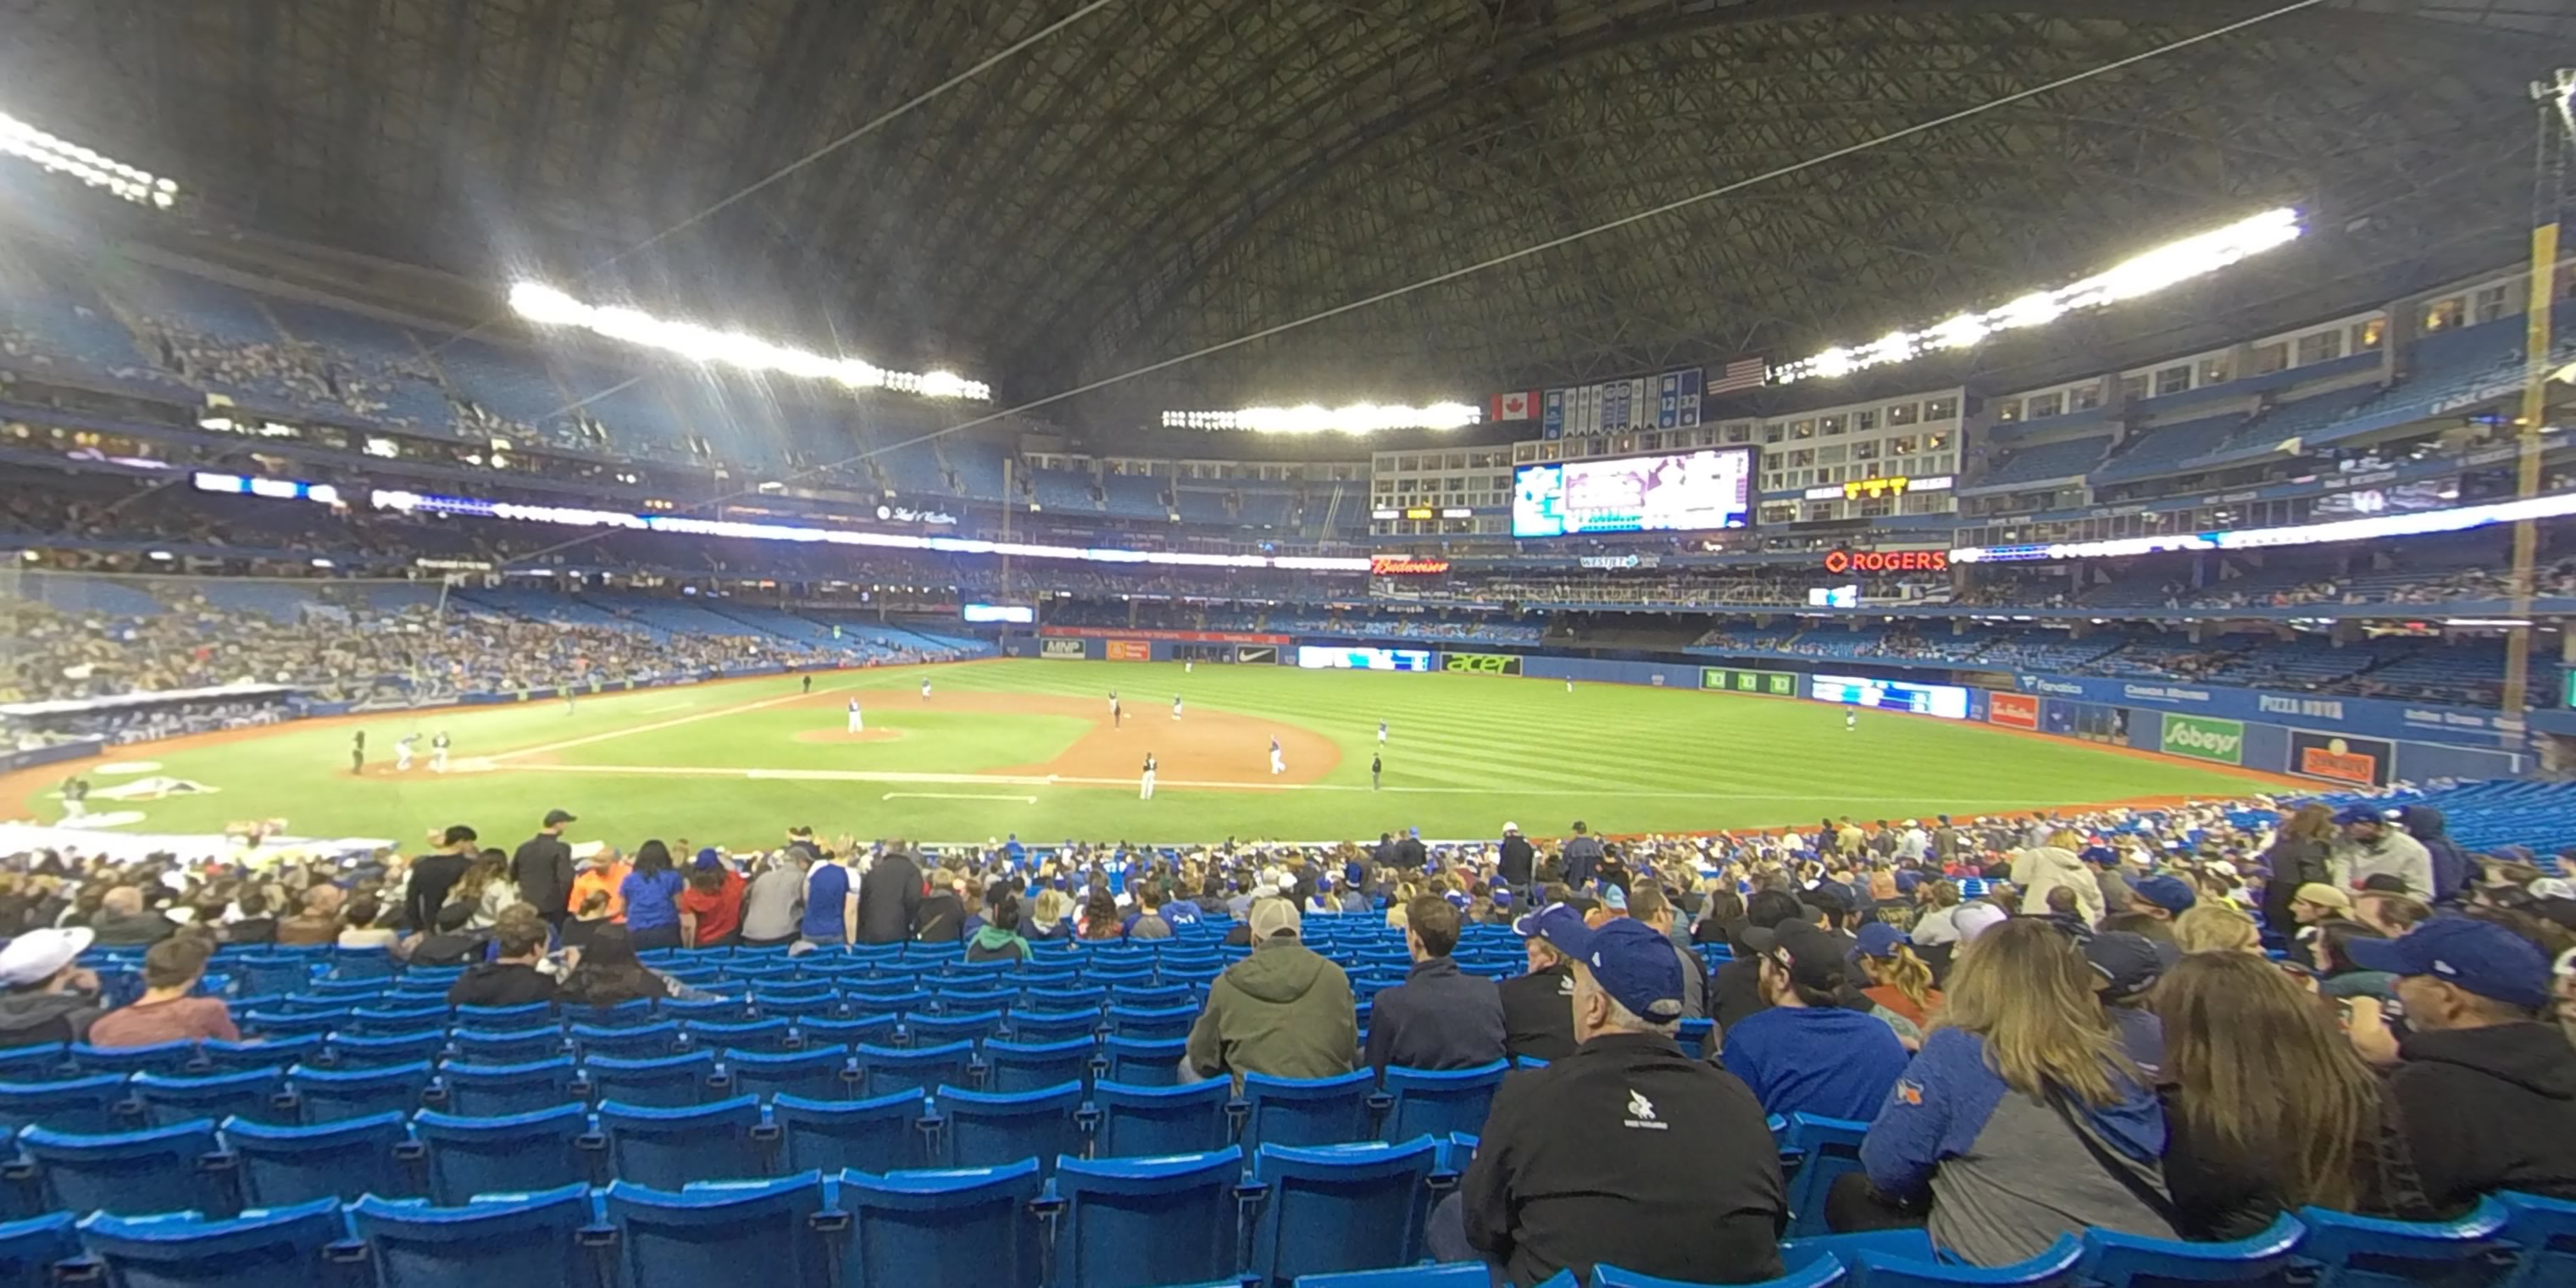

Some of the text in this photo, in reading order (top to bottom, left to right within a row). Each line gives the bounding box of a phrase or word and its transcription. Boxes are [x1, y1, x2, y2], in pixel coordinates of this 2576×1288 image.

[1661, 397, 1675, 412] 12
[1372, 559, 1449, 575] Budweiser
[1580, 556, 1629, 571] WESTJET
[1852, 552, 1946, 571] ROGERS
[1046, 641, 1080, 653] MNP
[1446, 654, 1514, 675] acer
[2037, 680, 2083, 694] Fanatics
[2165, 722, 2238, 754] Sobeys
